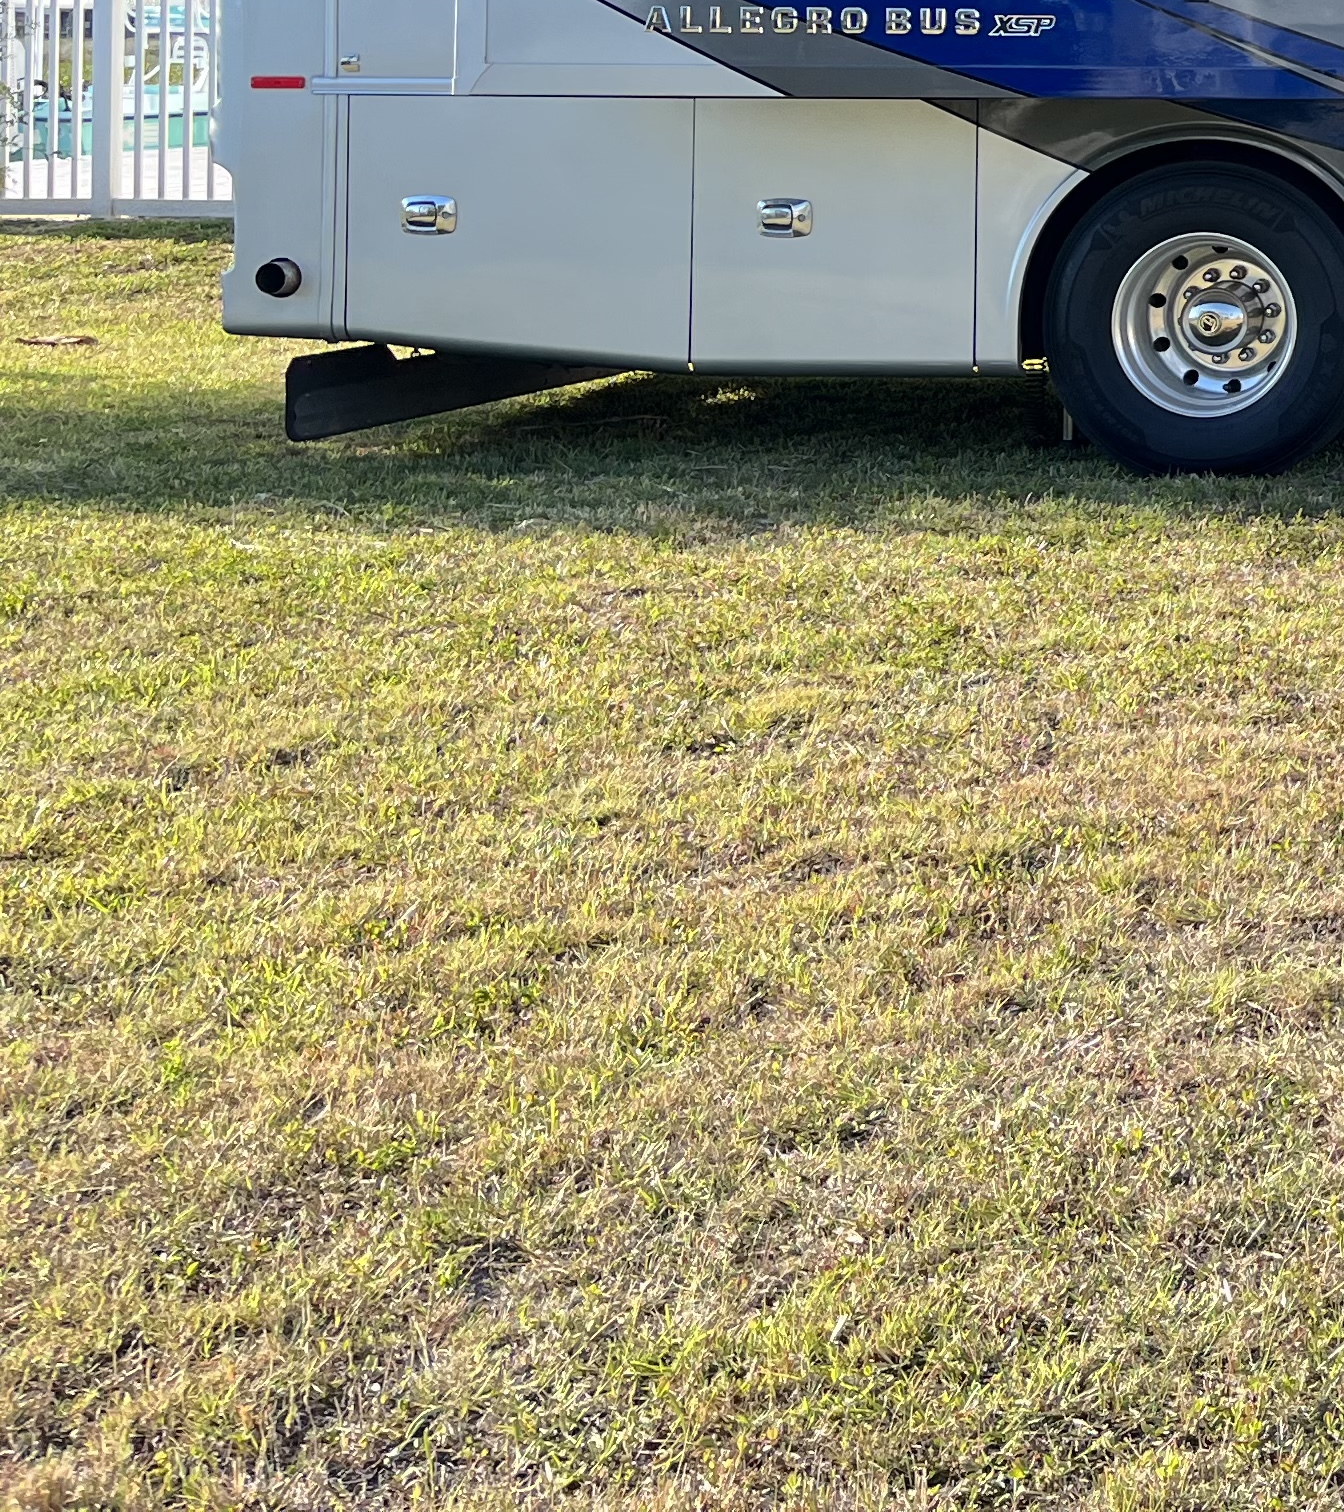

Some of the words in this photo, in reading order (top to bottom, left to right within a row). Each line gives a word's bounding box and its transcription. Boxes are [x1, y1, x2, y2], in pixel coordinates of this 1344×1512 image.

[644, 5, 868, 35] ALLEGRO
[885, 7, 981, 35] BUS
[988, 14, 1056, 36] XSP
[1140, 187, 1281, 220] MICHELIN
